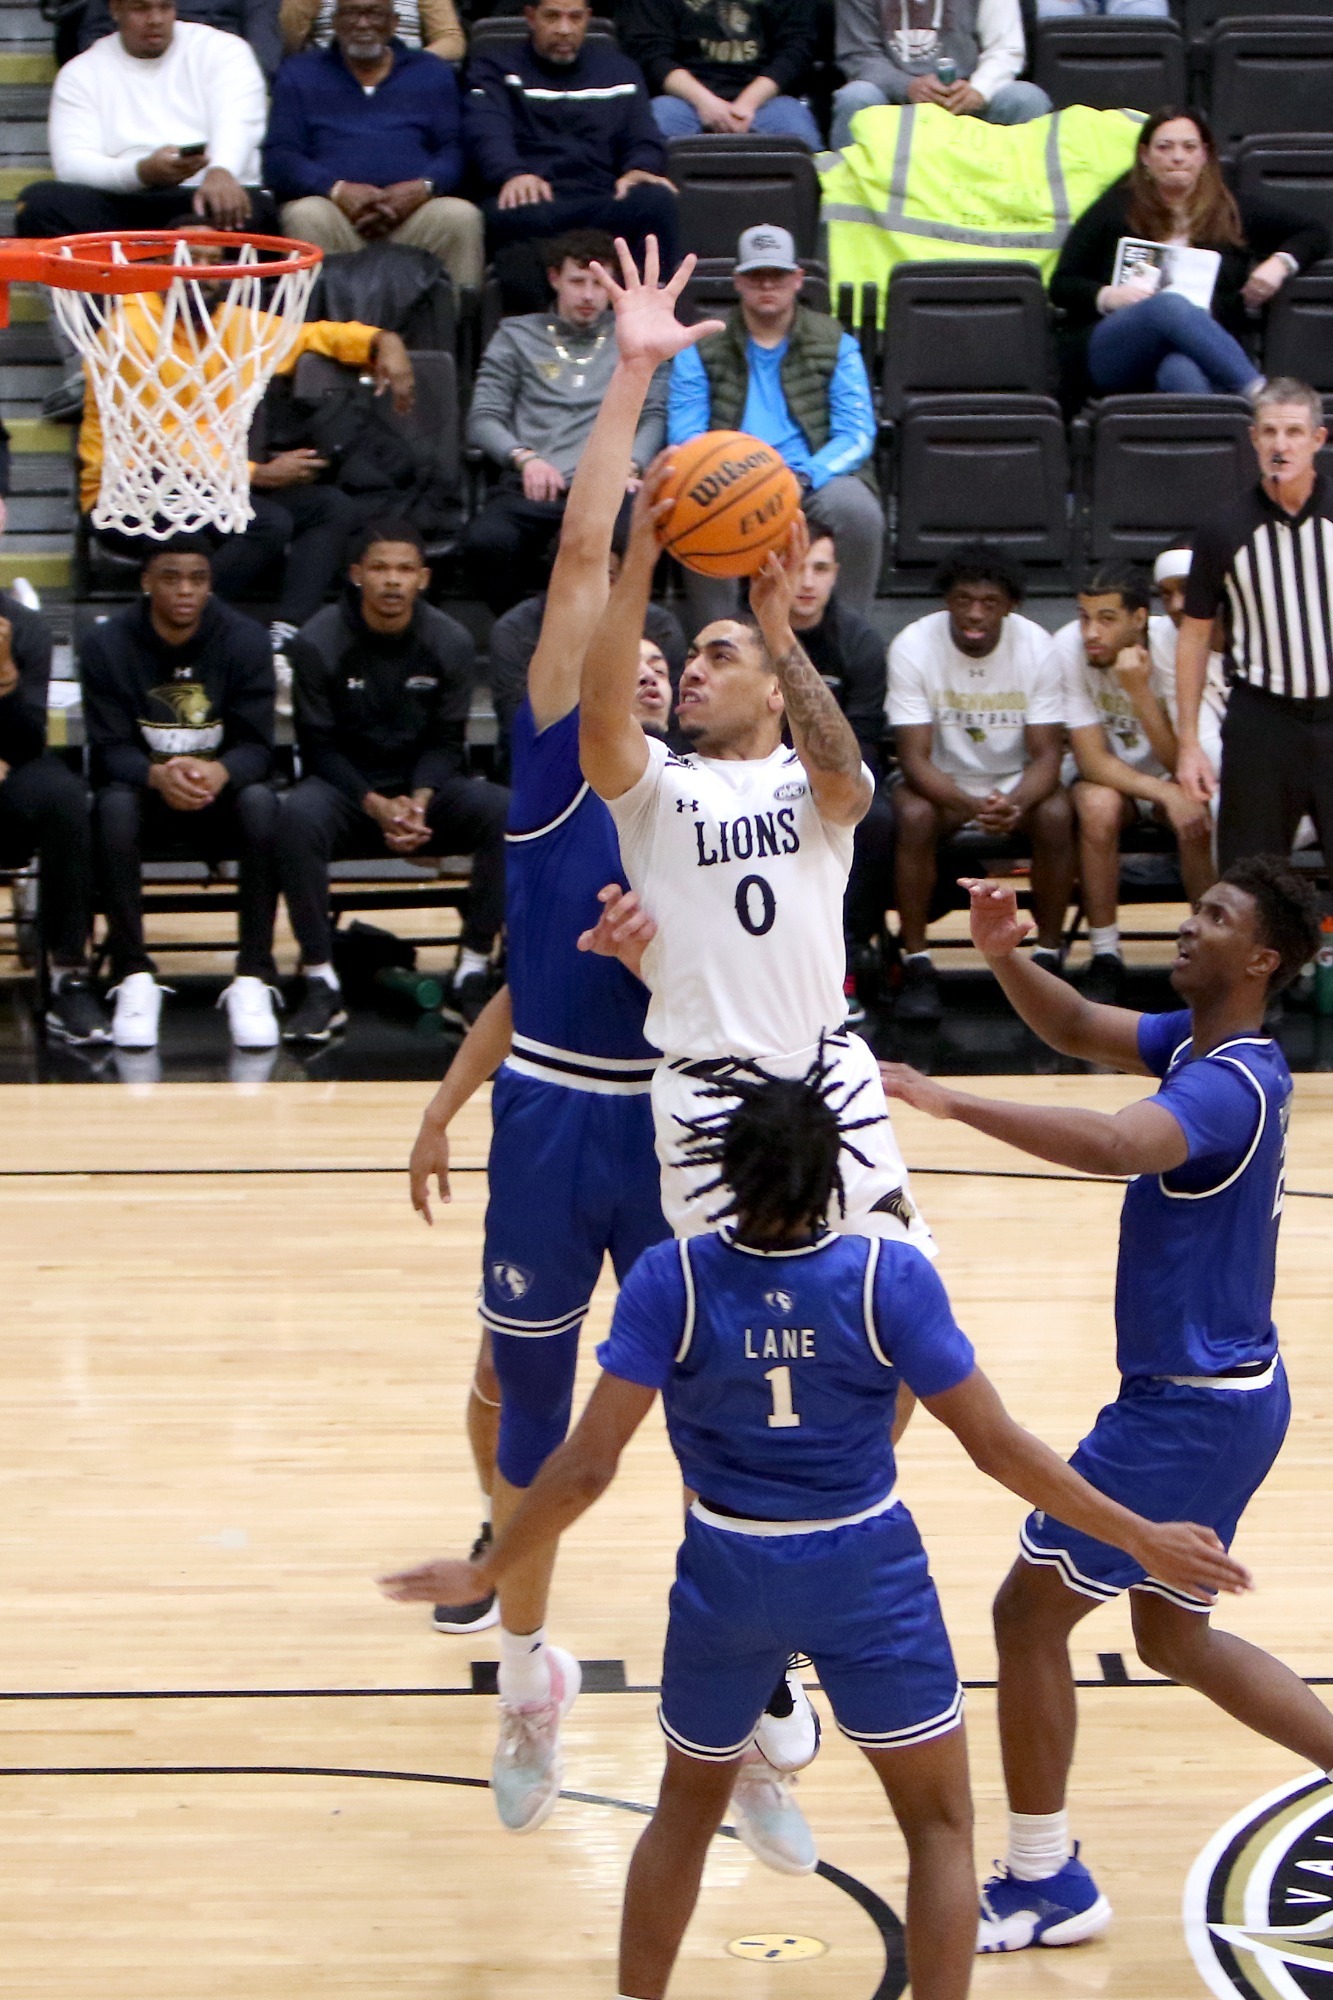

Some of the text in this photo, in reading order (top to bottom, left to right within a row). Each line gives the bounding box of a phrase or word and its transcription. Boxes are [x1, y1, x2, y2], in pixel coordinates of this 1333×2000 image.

[688, 451, 773, 507] Wilson
[694, 807, 801, 867] LIONS
[734, 873, 777, 936] 0
[744, 1328, 816, 1359] LANE
[764, 1365, 801, 1428] 1
